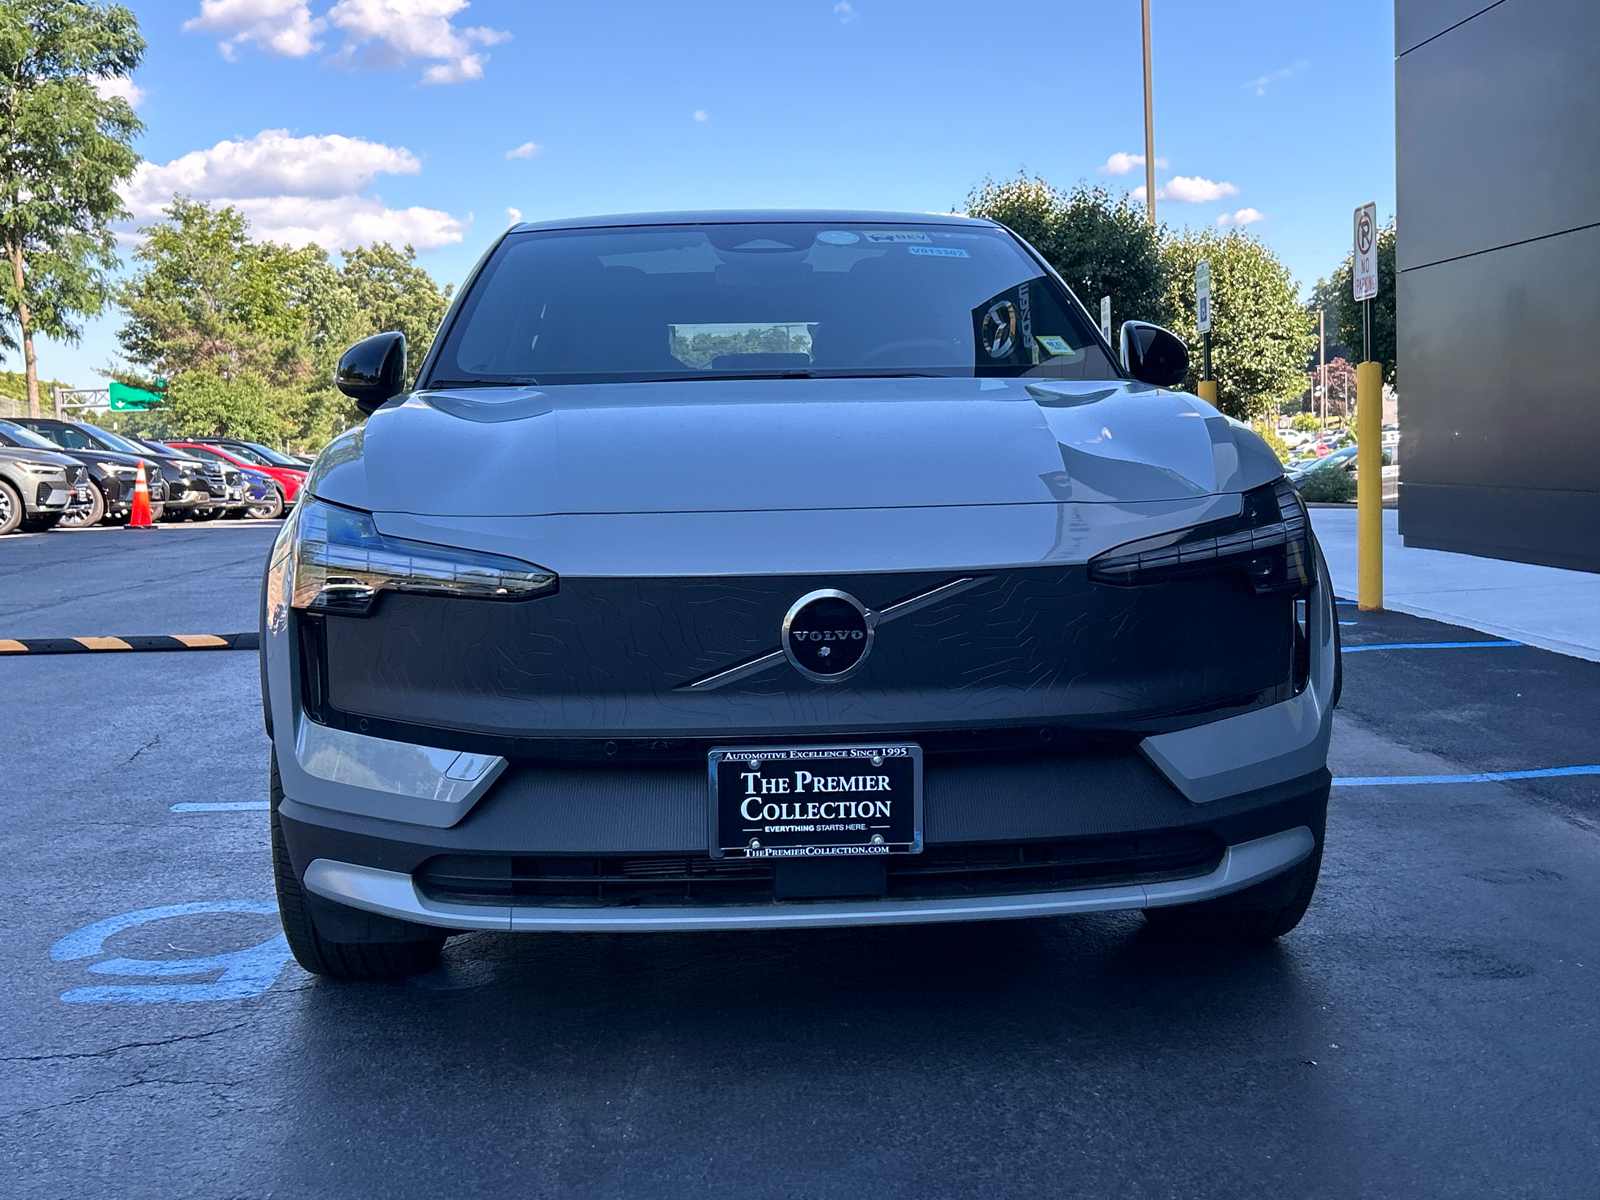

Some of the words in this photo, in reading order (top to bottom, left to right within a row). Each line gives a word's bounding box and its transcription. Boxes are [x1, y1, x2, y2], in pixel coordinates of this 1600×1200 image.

[911, 247, 965, 257] V013302
[1361, 257, 1370, 275] NO
[792, 629, 864, 641] VOLVO
[724, 751, 787, 761] AUTOMOTIVE
[789, 750, 848, 759] EXCELLENCE
[850, 748, 879, 757] SINCE
[881, 747, 907, 757] 1995
[740, 771, 790, 795] THE
[794, 770, 892, 793] PREMIER
[740, 796, 892, 821] COLLECTION
[764, 825, 815, 833] EVERYTHING
[816, 824, 845, 832] STARTS
[845, 823, 868, 831] HERE.
